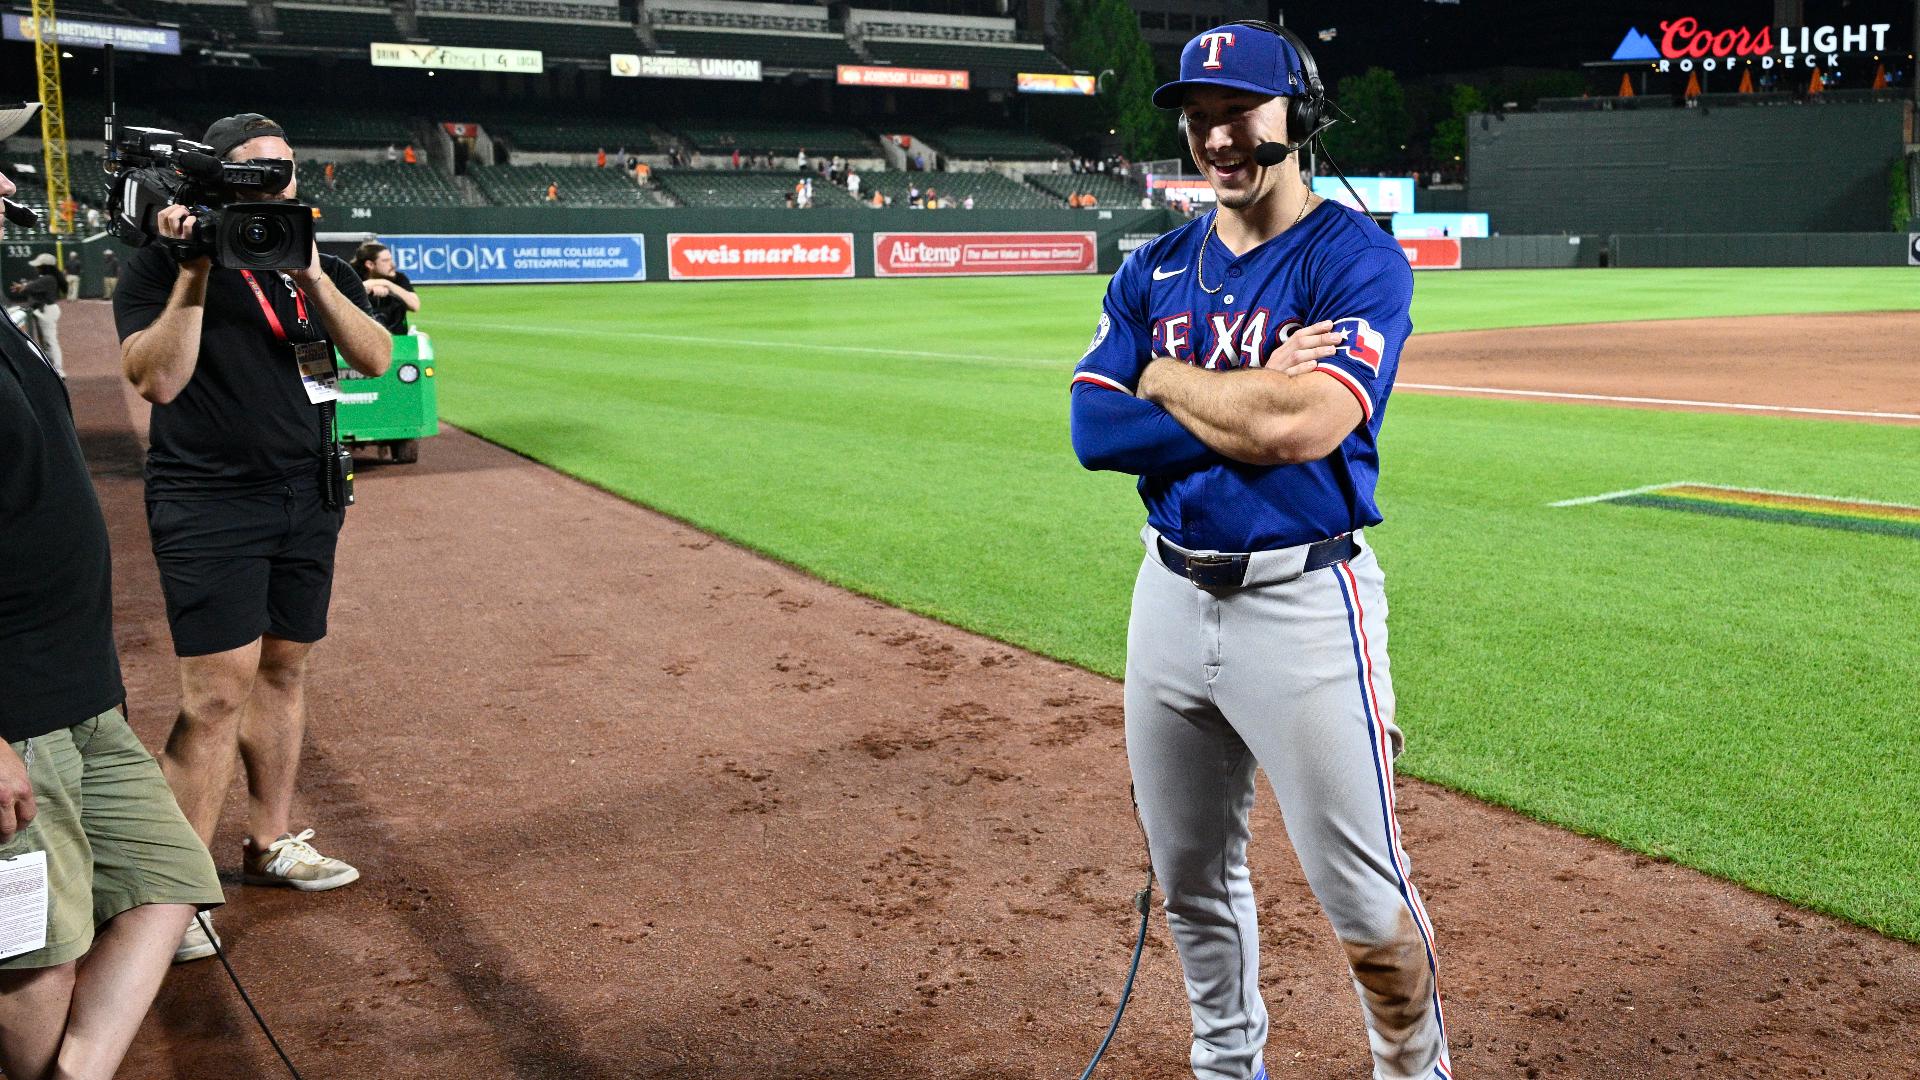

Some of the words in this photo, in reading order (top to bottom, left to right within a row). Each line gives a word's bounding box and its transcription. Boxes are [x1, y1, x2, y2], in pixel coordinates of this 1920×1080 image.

[1660, 16, 1773, 59] Coors
[1780, 23, 1891, 55] LIGHT
[1200, 32, 1235, 70] T
[701, 59, 759, 78] UNION
[1660, 57, 1736, 72] ROOF
[1762, 53, 1838, 69] DECK
[8, 244, 31, 257] 333
[397, 246, 507, 271] ECOM
[513, 247, 539, 257] LAKE
[541, 247, 561, 257] ERIE
[564, 247, 606, 257] COLLEGE
[608, 247, 621, 256] OF
[683, 244, 741, 264] weis
[743, 244, 841, 264] markets
[890, 241, 961, 263] Airtemp
[967, 250, 980, 259] The
[982, 250, 999, 259] Best
[1000, 250, 1020, 259] Value
[1030, 249, 1051, 258] Home
[1052, 248, 1079, 258] Comfort
[514, 258, 581, 269] OSTEOPATHIC
[583, 258, 629, 268] MEDICINE
[1152, 306, 1304, 370] EXA
